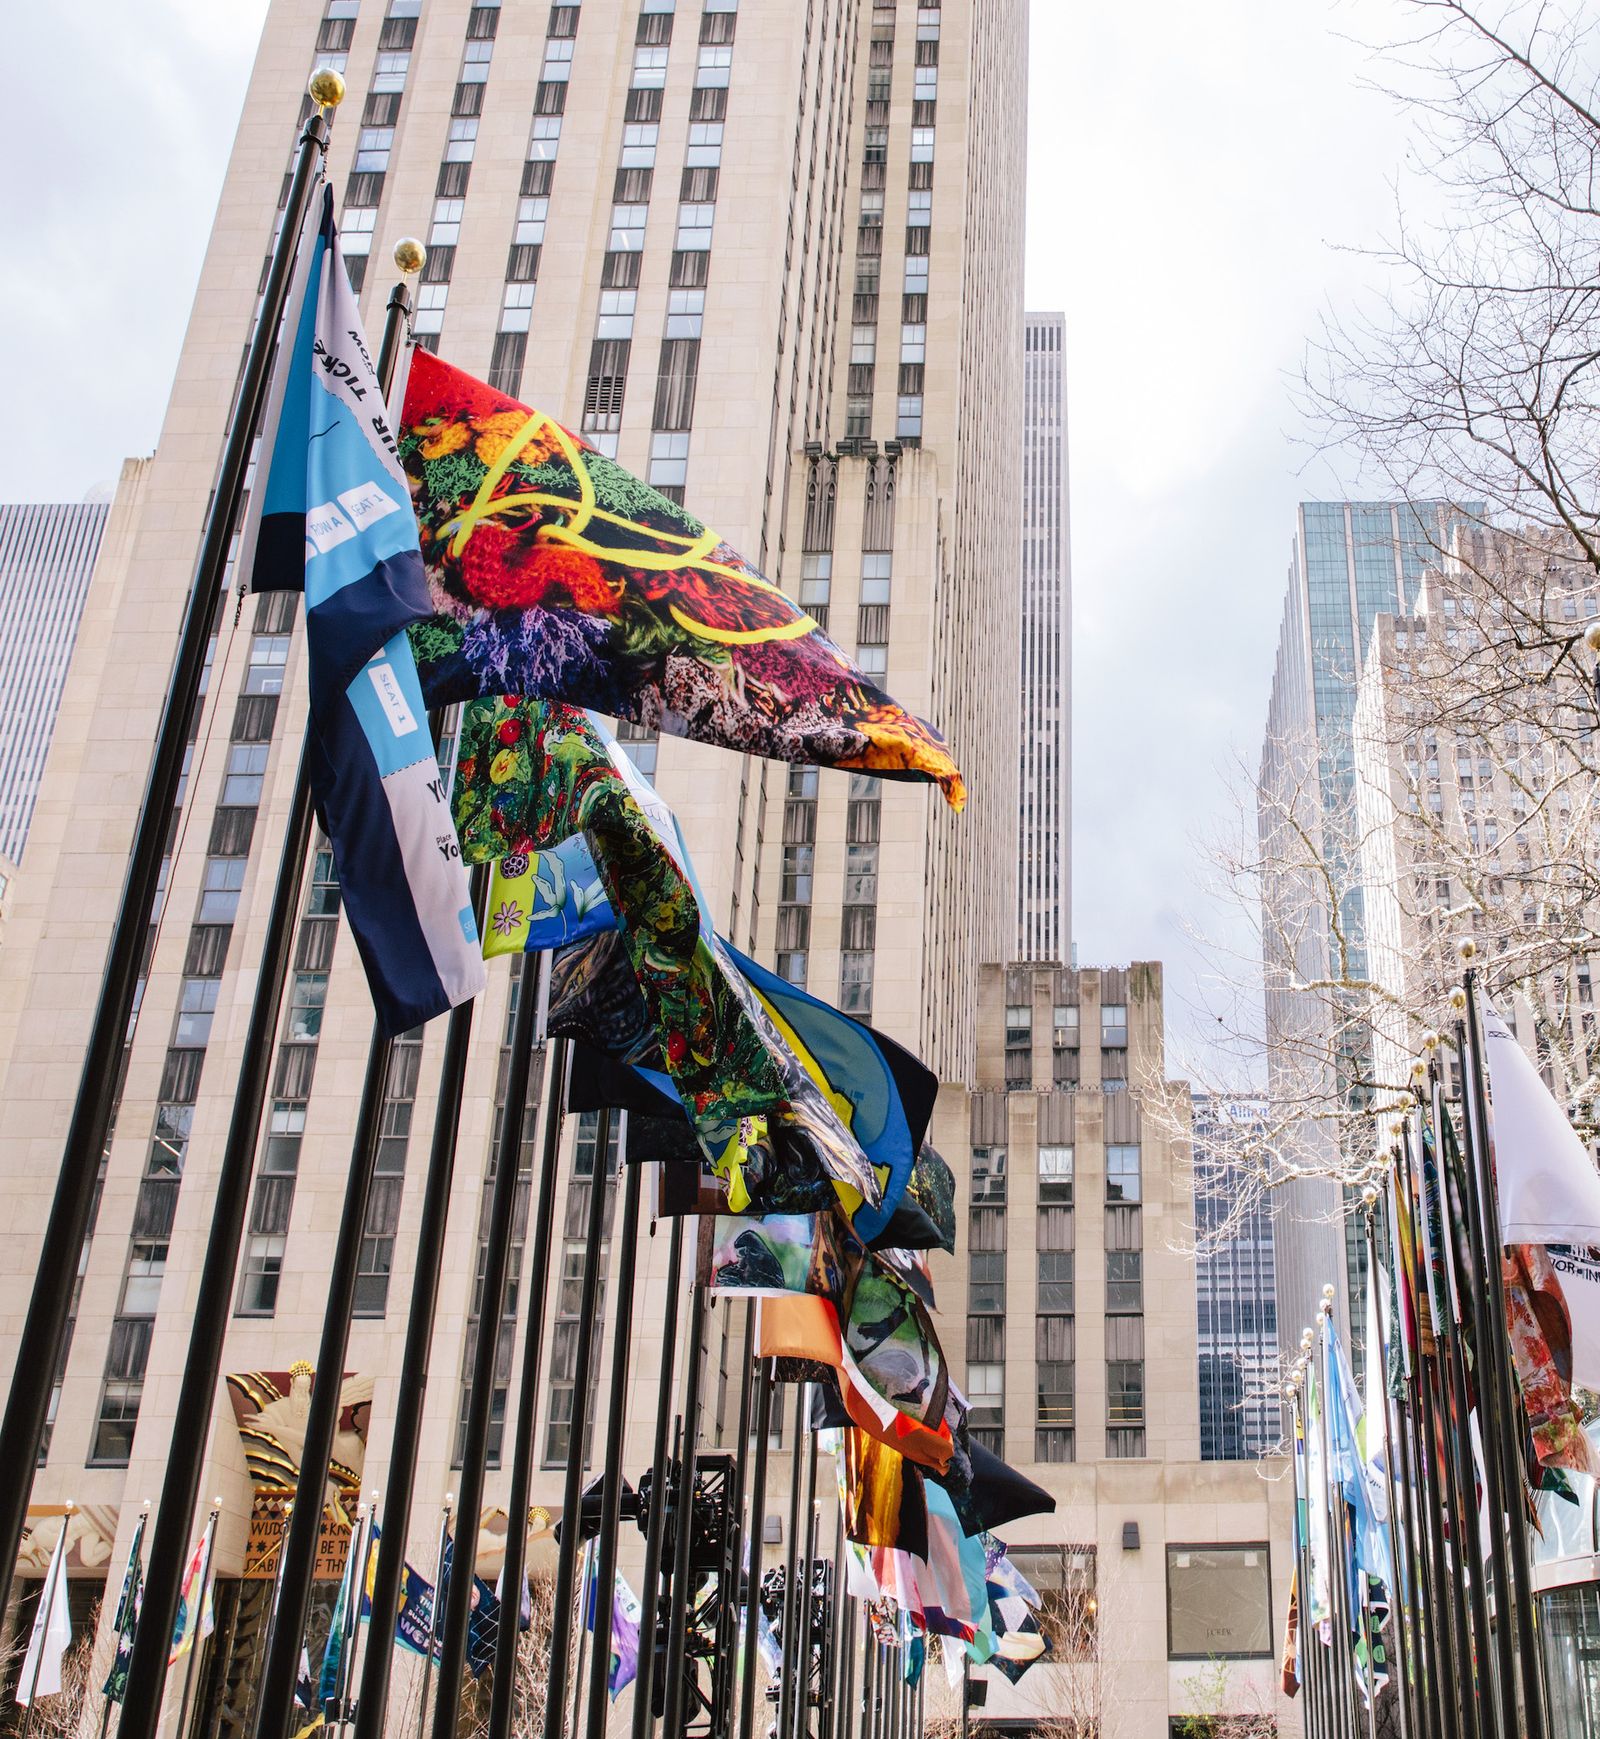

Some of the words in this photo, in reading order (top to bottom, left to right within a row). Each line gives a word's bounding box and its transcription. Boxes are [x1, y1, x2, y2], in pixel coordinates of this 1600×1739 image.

[331, 516, 343, 528] A
[380, 673, 399, 706] SEAT
[321, 1540, 335, 1554] BE
[327, 1558, 347, 1573] THY
